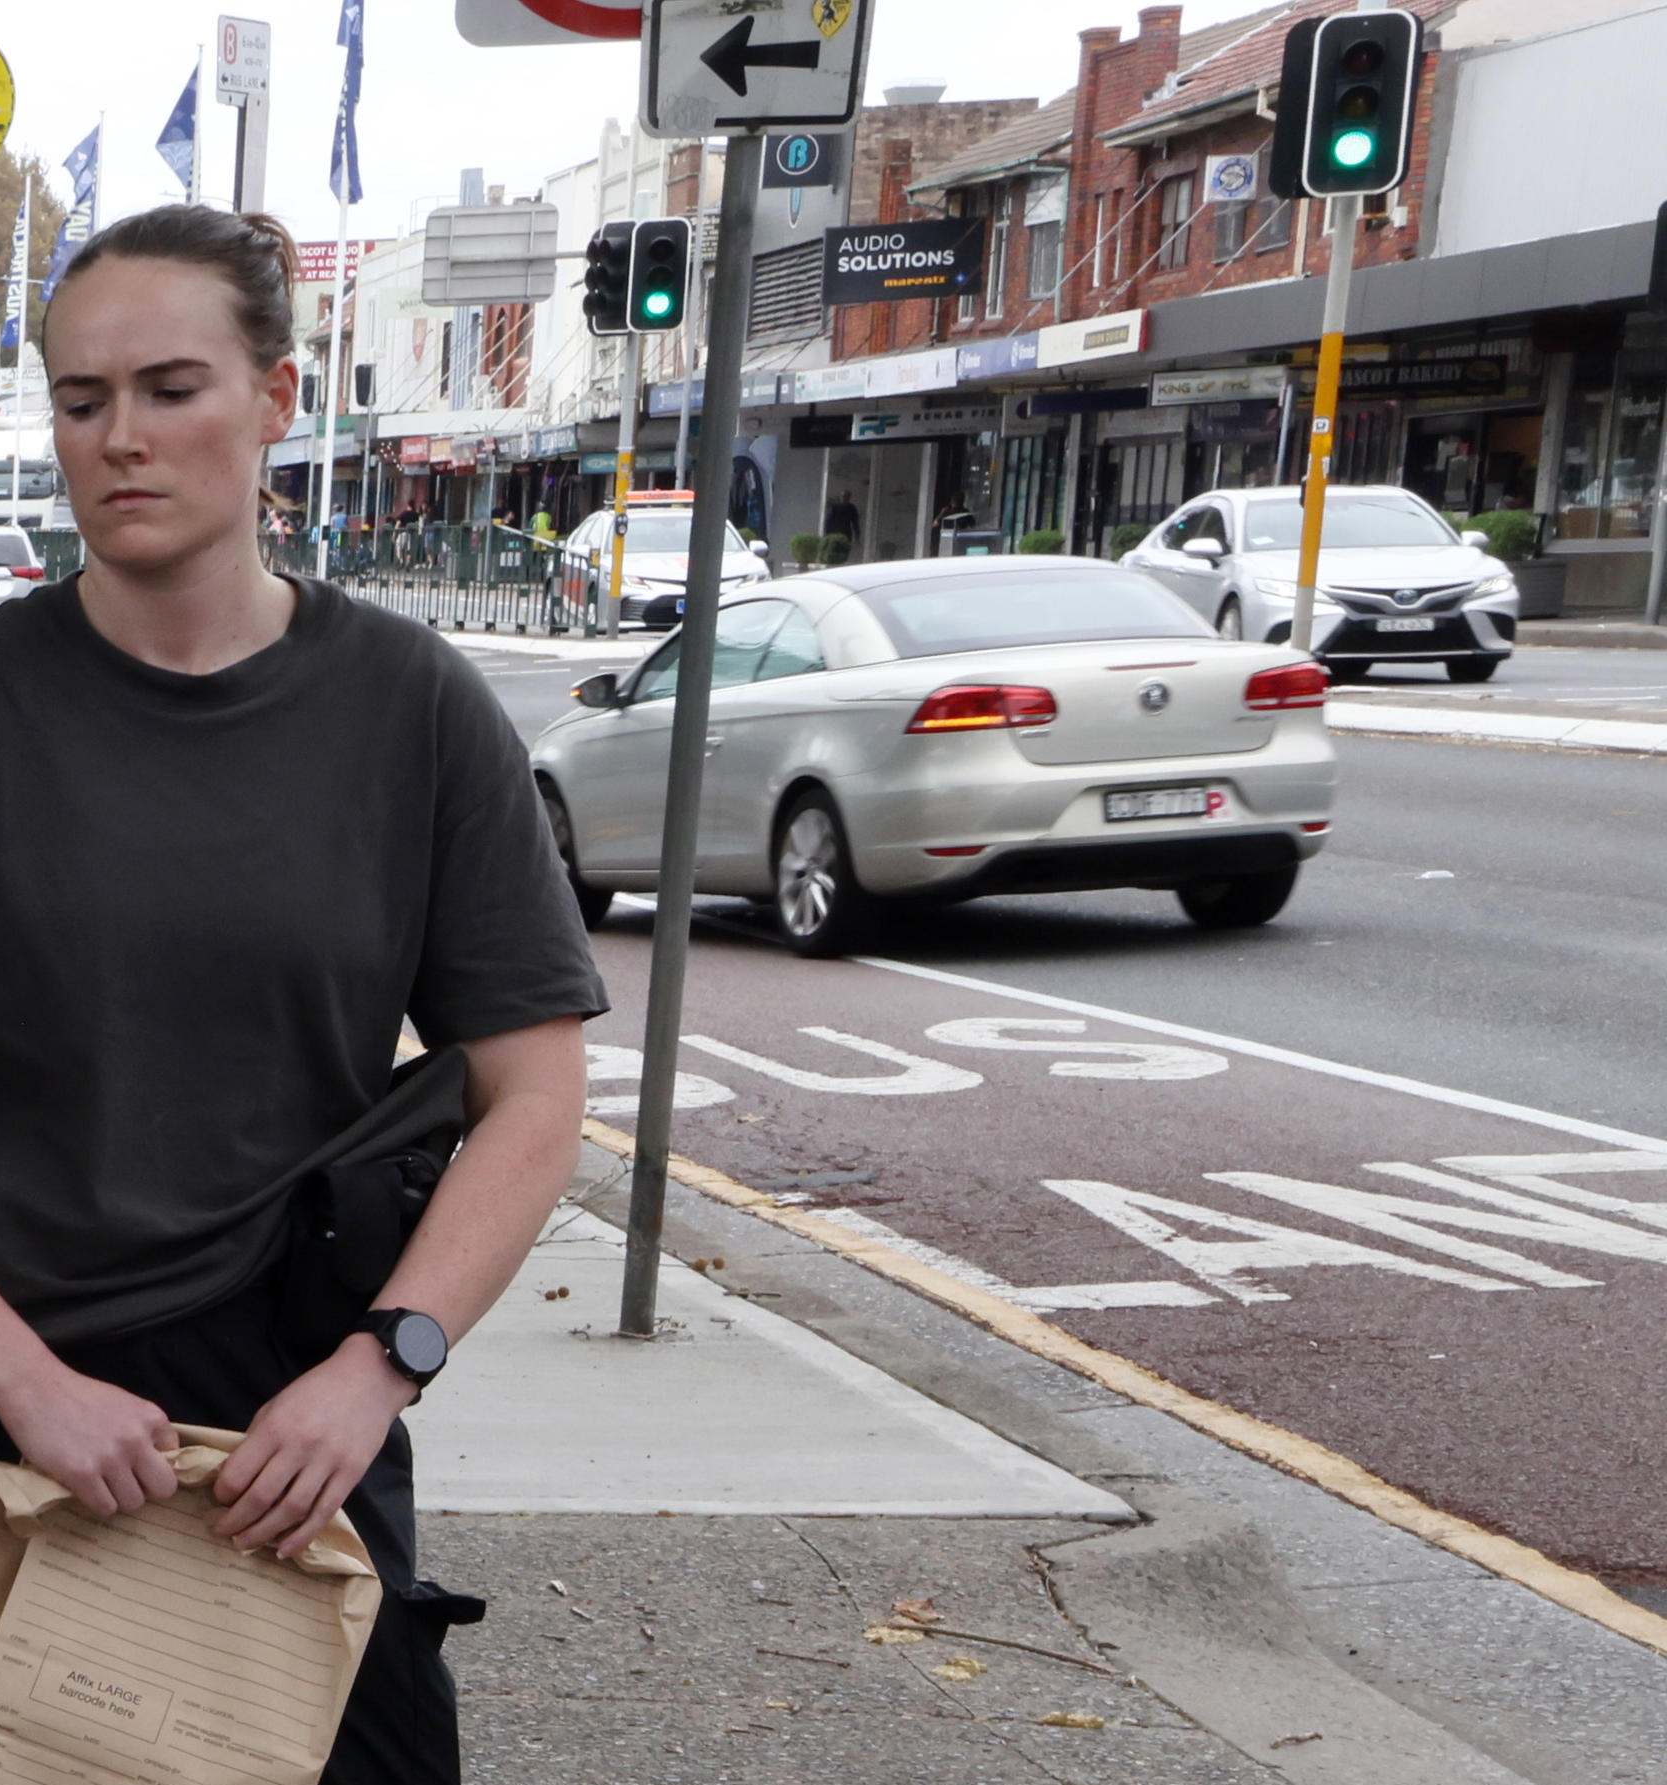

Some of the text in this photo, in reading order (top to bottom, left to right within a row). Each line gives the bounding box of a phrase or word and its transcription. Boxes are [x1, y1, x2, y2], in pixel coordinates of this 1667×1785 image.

[297, 246, 326, 256] SCOT
[839, 234, 905, 254] AUDIO
[837, 249, 955, 273] SOLUTIONS
[319, 269, 337, 279] REA
[1338, 367, 1392, 387] ASCOT
[67, 1671, 143, 1706] Affix LARGE
[59, 1683, 136, 1720] barcode here
